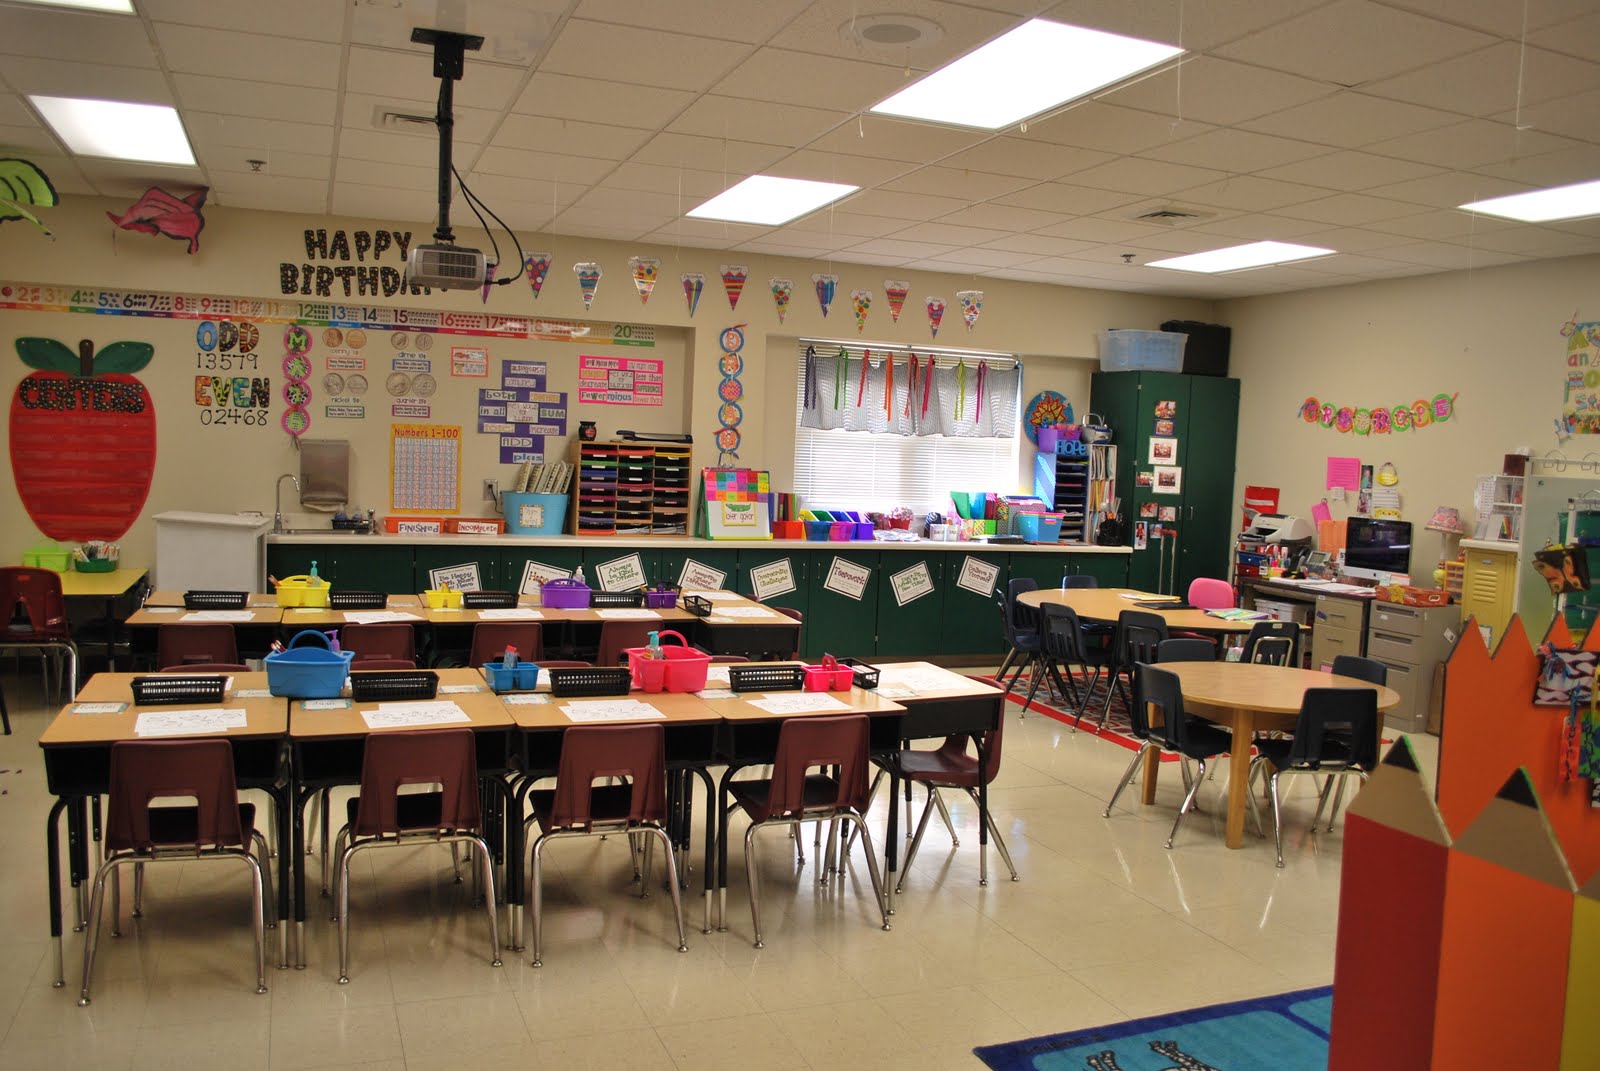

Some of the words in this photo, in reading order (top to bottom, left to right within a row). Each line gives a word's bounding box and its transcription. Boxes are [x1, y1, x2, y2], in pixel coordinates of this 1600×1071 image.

[304, 229, 412, 261] HAPPY
[280, 263, 431, 297] BIRTHD
[18, 286, 28, 302] 2
[45, 288, 55, 303] 3
[71, 290, 81, 304] 4
[98, 292, 109, 306] 5
[123, 294, 133, 308] 6
[148, 295, 158, 309] 7
[174, 297, 184, 310] 8
[201, 298, 211, 312] 9
[233, 300, 249, 314] 10
[267, 302, 280, 316] 11
[298, 304, 313, 318] 12
[331, 306, 346, 320] 13
[362, 307, 377, 322] 14
[393, 309, 408, 323] 15
[439, 312, 454, 326] 16
[484, 315, 499, 328] 17
[530, 319, 542, 332] 18
[614, 324, 632, 338] 20
[197, 321, 259, 352] ODD
[197, 353, 258, 370] 13579
[398, 351, 416, 359] dime
[580, 380, 607, 388] decrease
[19, 377, 146, 414] CENTERS
[195, 376, 271, 408] EVEN
[607, 392, 632, 402] minus
[480, 406, 489, 415] in
[493, 407, 505, 416] all
[541, 409, 565, 418] SUM
[201, 410, 268, 426] 02468
[394, 428, 428, 438] Numbers
[431, 428, 459, 438] 1-100
[502, 438, 532, 447] ADD
[513, 454, 543, 462] plus
